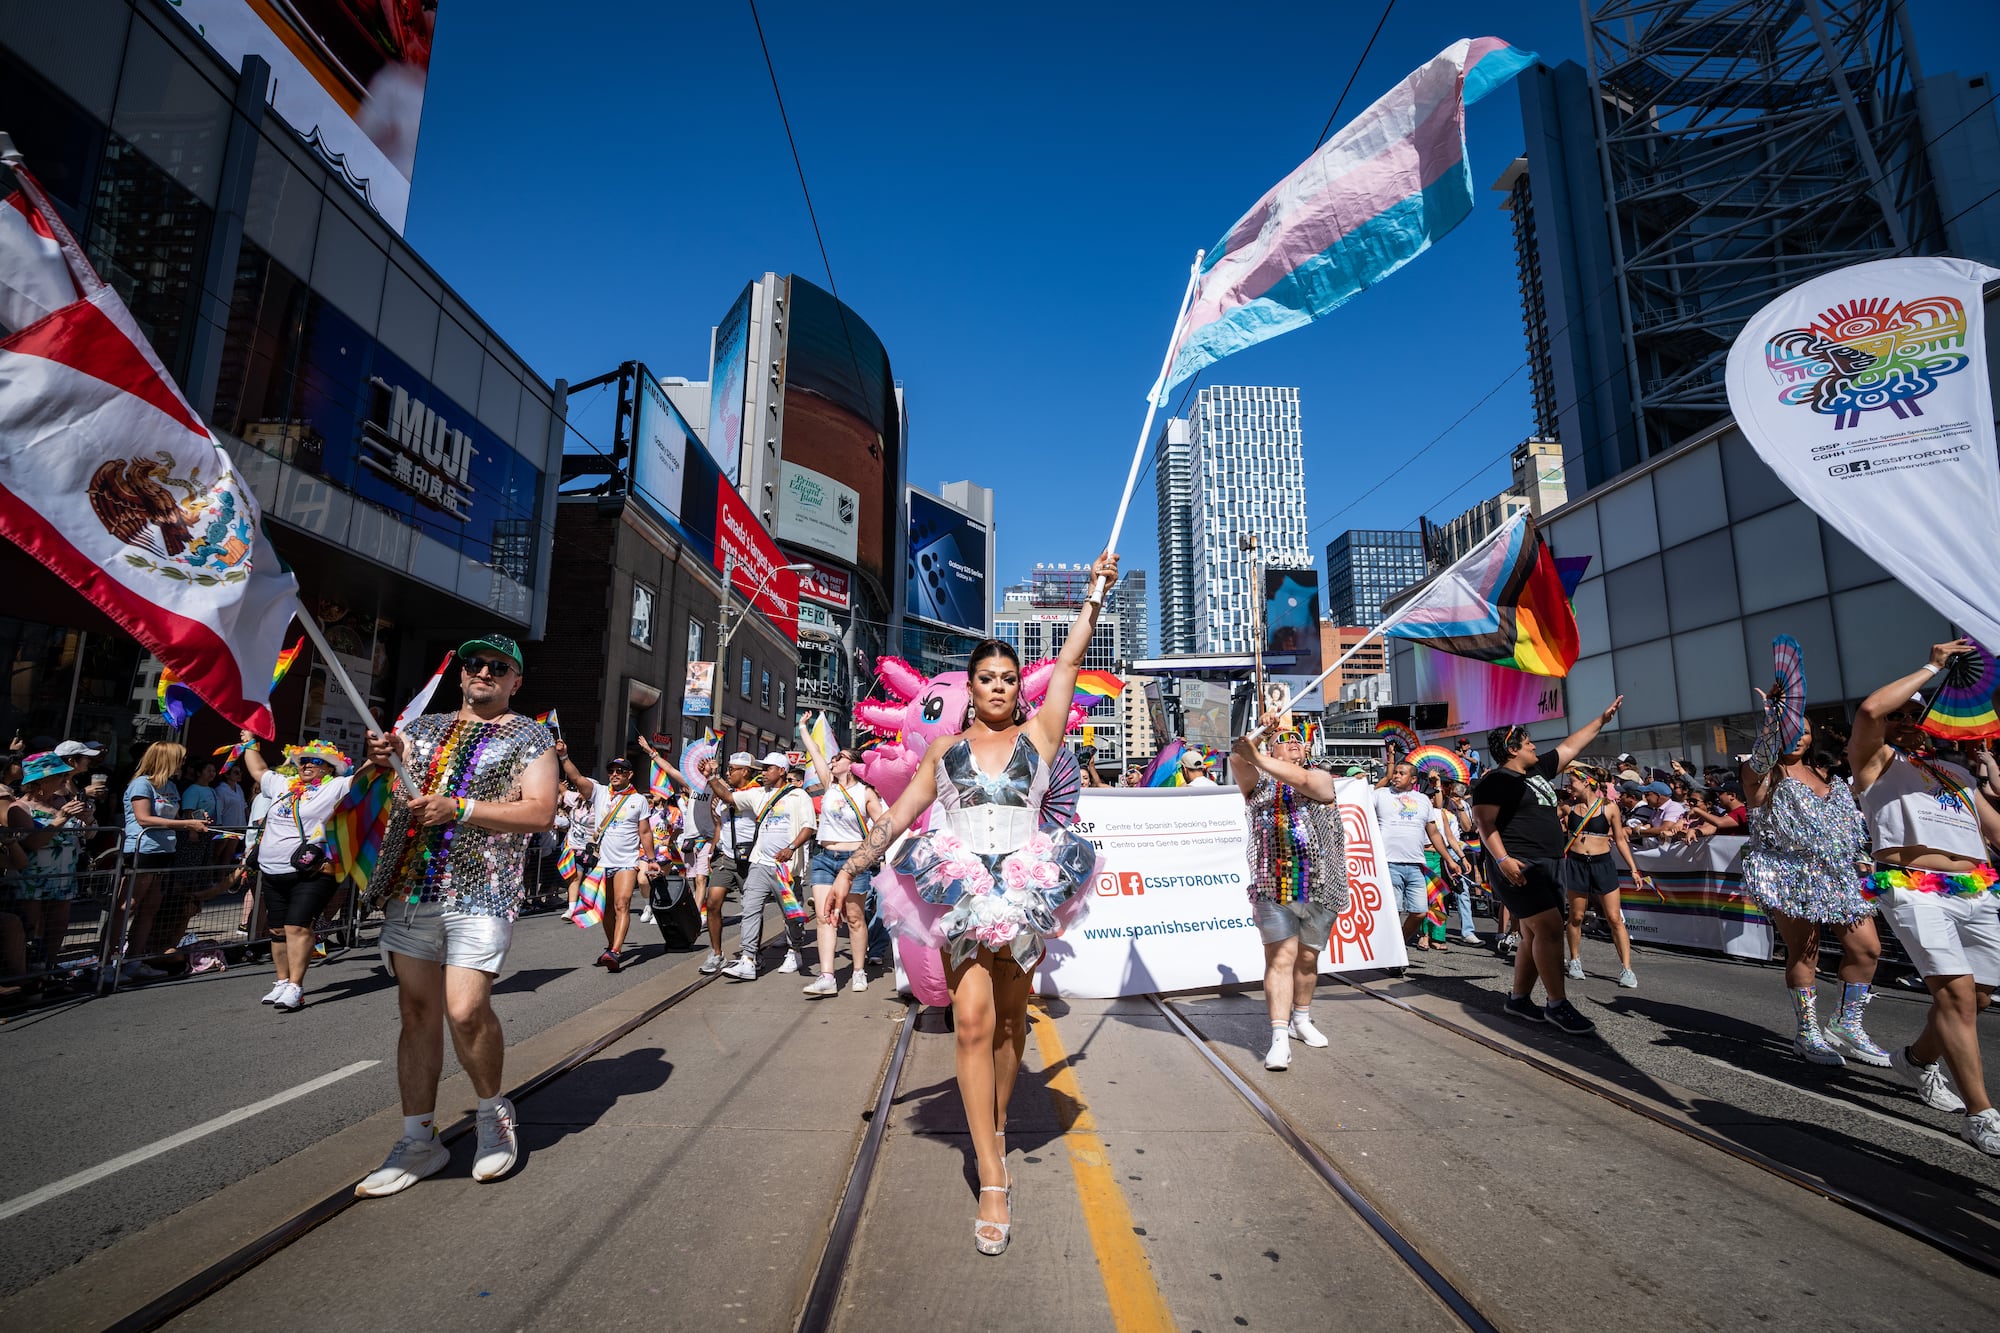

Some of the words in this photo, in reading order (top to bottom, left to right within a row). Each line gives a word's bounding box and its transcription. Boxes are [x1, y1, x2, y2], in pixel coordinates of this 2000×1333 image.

[644, 378, 669, 416] SAMSUNG
[388, 385, 472, 483] MUJI
[1811, 442, 1840, 453] CSSP
[1846, 438, 1869, 446] Centre
[1880, 431, 1906, 442] Spanish
[1907, 426, 1940, 438] Speaking
[1940, 420, 1969, 430] Peoples
[1812, 450, 1845, 462] CGHH
[1848, 446, 1870, 454] Centro
[1943, 428, 1972, 438] Hispana
[1872, 444, 1971, 466] CSSPTORONTO
[1840, 456, 1960, 480] www.spanishservices.org
[394, 452, 458, 511] 無印良品
[789, 480, 820, 497] Edward
[796, 474, 821, 492] Prince
[800, 492, 823, 506] Island
[967, 520, 986, 534] SAMSUNG
[720, 536, 738, 564] most
[722, 503, 750, 552] Canada's
[750, 534, 768, 572] largest
[768, 565, 777, 582] and
[948, 560, 964, 572] Galaxy
[971, 568, 983, 578] Series
[1266, 552, 1314, 568] Citytv
[797, 640, 836, 654] NEPLEX
[1538, 688, 1558, 714] H&M
[1106, 823, 1131, 831] Centre
[1145, 822, 1172, 830] Spanish
[1174, 820, 1207, 830] Speaking
[1208, 819, 1237, 828] Peoples
[1110, 841, 1136, 849] Centro
[1137, 841, 1155, 849] para
[1156, 839, 1179, 847] Gente
[1192, 837, 1214, 845] Habla
[1215, 836, 1242, 845] Hispana
[1144, 873, 1241, 889] CSSPTORONTO
[1084, 916, 1256, 940] www.spanishservices.o
